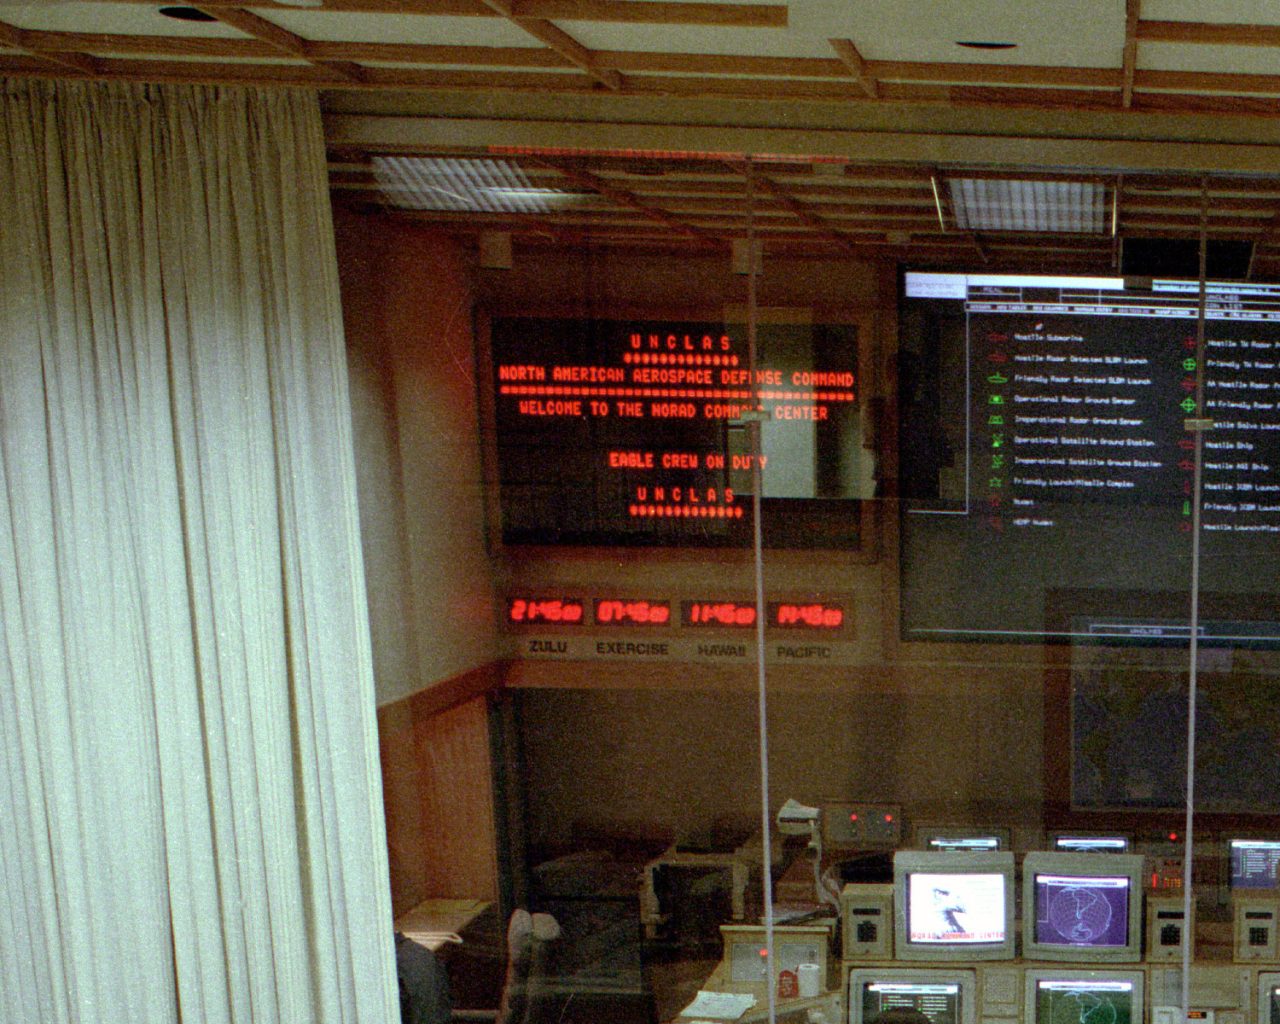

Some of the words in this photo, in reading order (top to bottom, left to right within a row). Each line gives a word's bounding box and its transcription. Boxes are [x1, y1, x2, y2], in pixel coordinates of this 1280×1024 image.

[499, 366, 545, 381] NORTH
[553, 367, 625, 382] AMERICAN
[633, 368, 712, 384] AEROSPACE
[721, 370, 783, 386] DEFNSE
[792, 371, 854, 387] COMMAND
[519, 401, 582, 416] WELCOME
[590, 402, 608, 416] TO
[617, 402, 643, 417] THE
[651, 403, 696, 418] NORAD
[704, 404, 765, 419] COMM
[775, 405, 828, 420] CENTER
[609, 452, 654, 468] EAGLE
[662, 453, 698, 469] CREW
[706, 454, 724, 469] ON
[732, 454, 767, 470] DUY
[529, 641, 567, 652] ZULU
[597, 642, 669, 654] EXERCISE
[777, 647, 831, 658] PACIFIC
